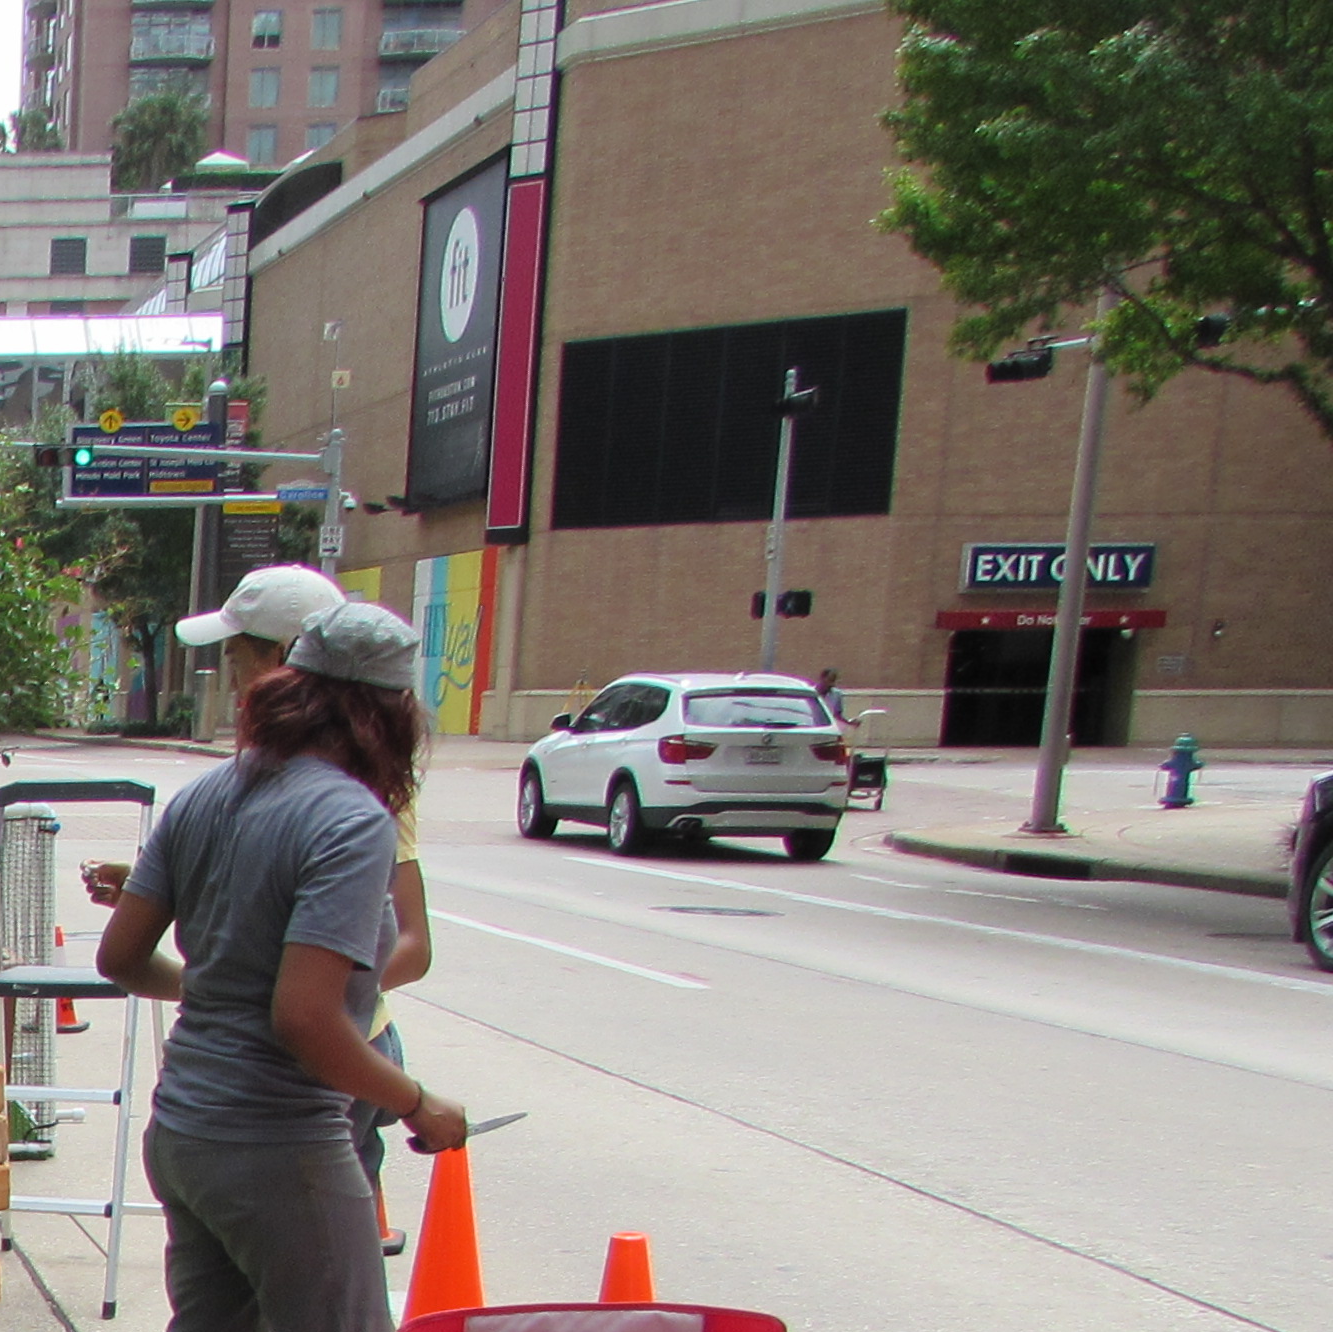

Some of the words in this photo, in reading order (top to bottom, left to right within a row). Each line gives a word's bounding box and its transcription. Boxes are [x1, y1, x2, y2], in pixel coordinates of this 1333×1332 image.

[150, 434, 179, 444] Toyota
[974, 553, 1044, 582] EXIT
[1017, 614, 1035, 625] Do
